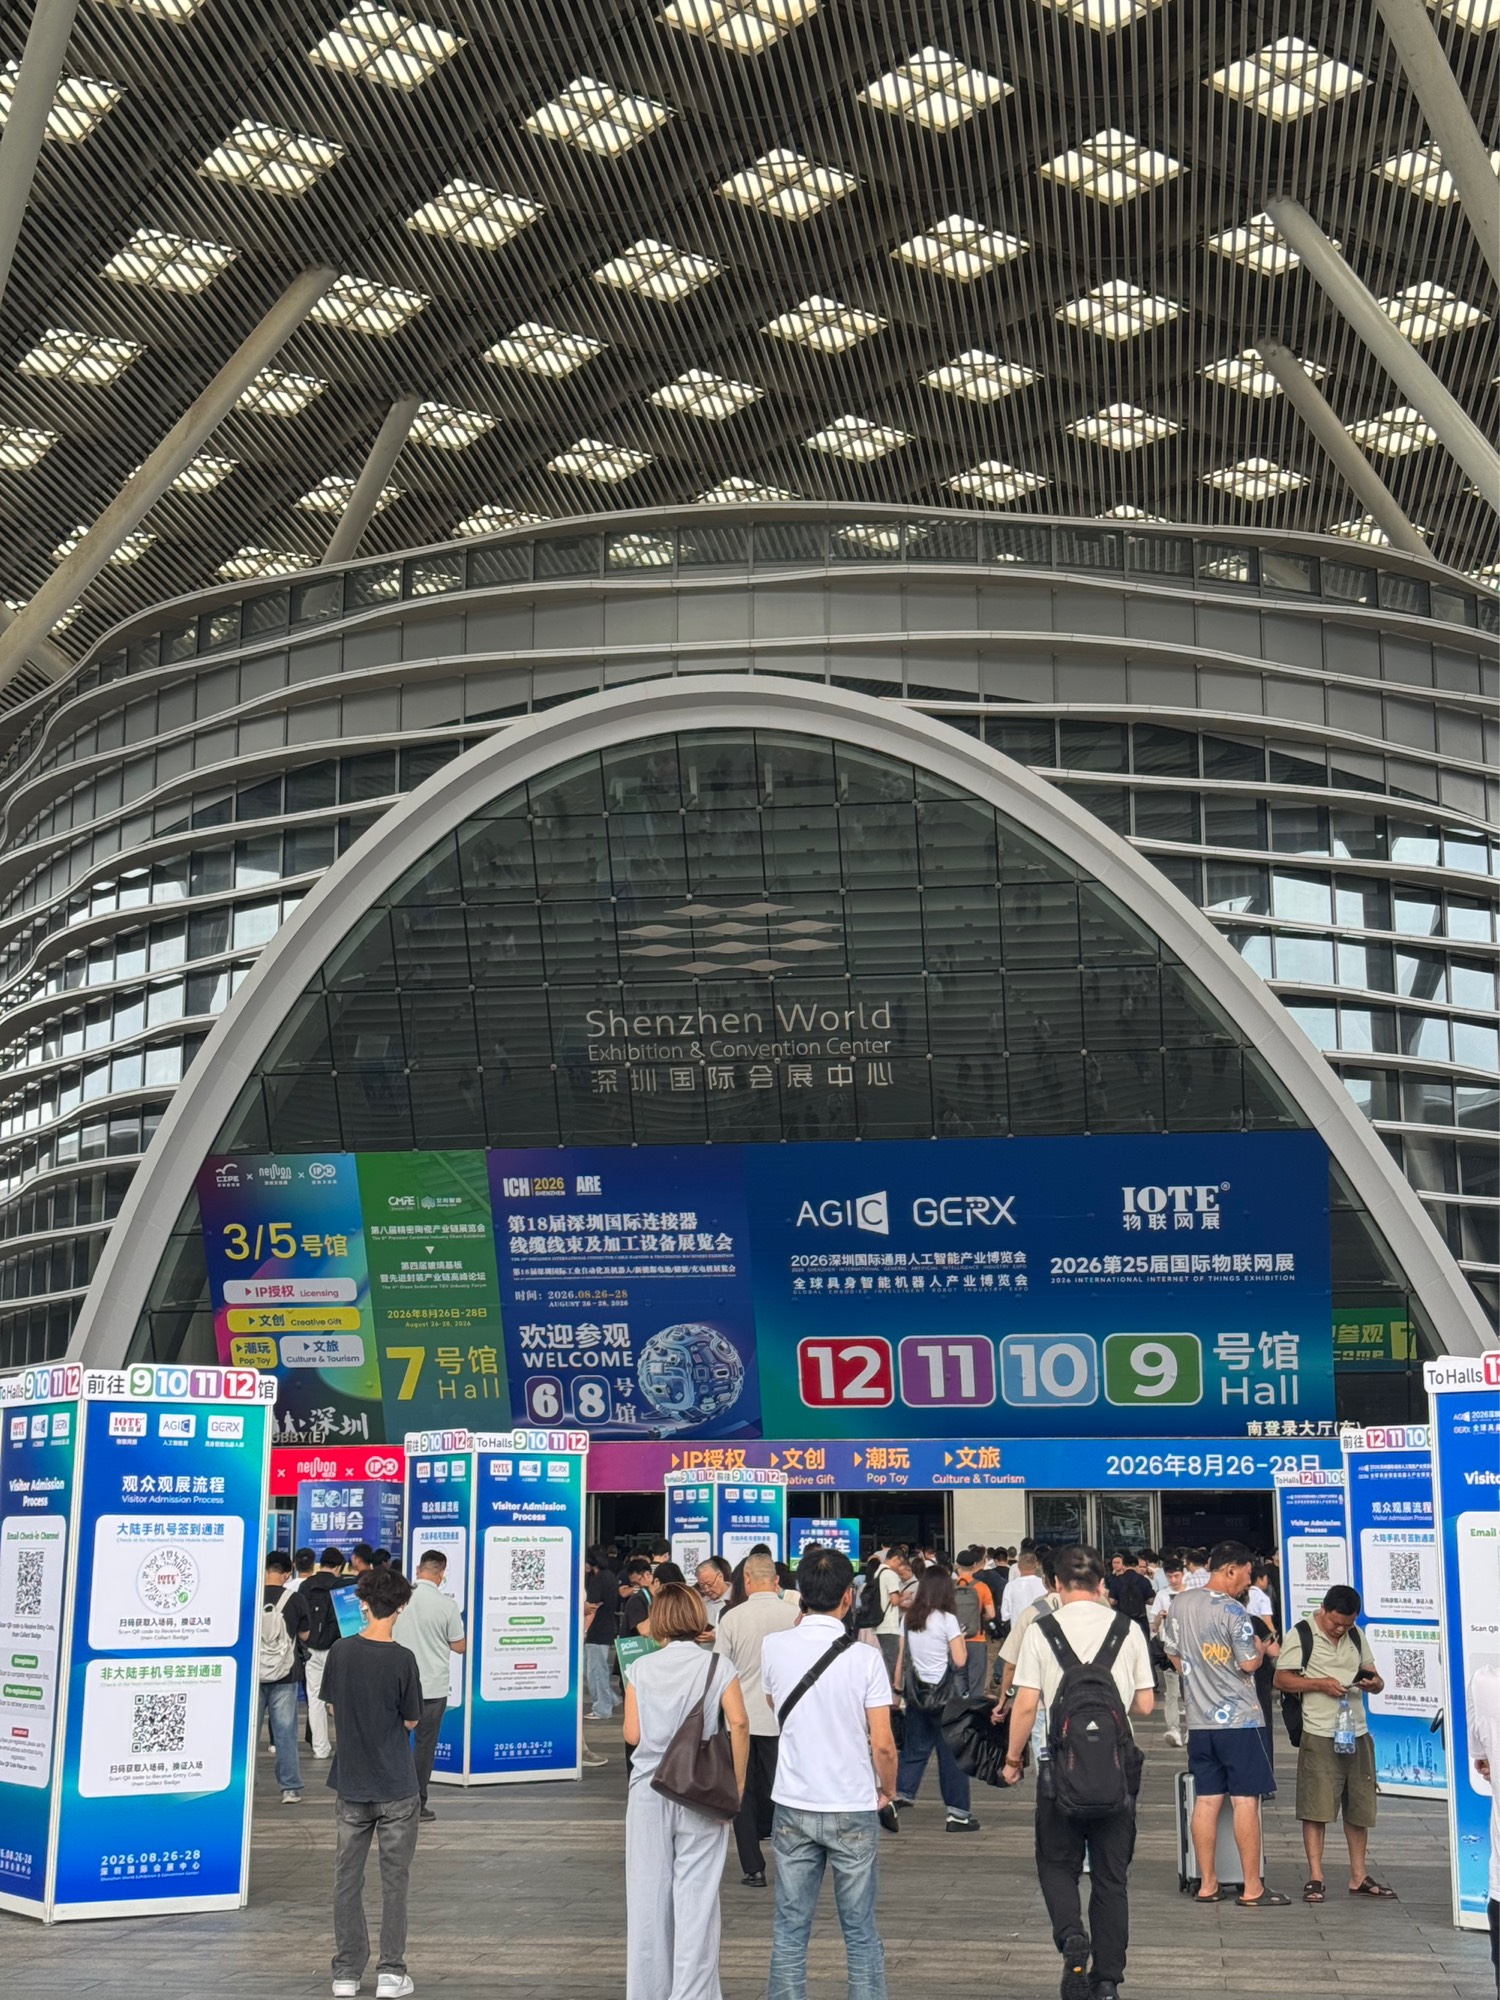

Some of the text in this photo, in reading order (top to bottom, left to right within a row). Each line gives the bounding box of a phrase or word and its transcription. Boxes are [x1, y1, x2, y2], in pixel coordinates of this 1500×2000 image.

[585, 1001, 891, 1038] Shenzhen World
[588, 1037, 891, 1062] Exhibition & Convention Center
[592, 1062, 894, 1094] 深圳国际会展中心
[502, 1175, 602, 1197] ICH 2026 ARE
[912, 1195, 1017, 1227] GERX
[507, 1211, 698, 1234] 第18届深圳国际连接器
[1122, 1212, 1220, 1232] 物联网展
[509, 1233, 734, 1255] 线缆线束及加工设备展览会
[401, 1260, 463, 1271] 第四届玻璃基板
[791, 1251, 1027, 1267] 2026深圳国际通用人工智能产业博览会
[1050, 1253, 1295, 1275] 2026第25届国际物联网展
[792, 1273, 1028, 1290] 全球具身智能机器人产业博览会
[1050, 1276, 1072, 1284] 2026
[1074, 1276, 1143, 1284] INTERNATIONAL
[1146, 1275, 1190, 1283] INTERNET
[1208, 1275, 1241, 1283] THINGS
[1243, 1274, 1296, 1282] EXHIBITION
[255, 1285, 339, 1298] IP授权 Licensing
[549, 1300, 580, 1308] AUGUST
[259, 1313, 342, 1327] 文创 Creative Gift
[387, 1308, 488, 1319] 2026年8月26日-28日
[519, 1322, 632, 1349] 欢迎参观
[1332, 1324, 1384, 1344] 参观
[244, 1340, 339, 1354] 潮玩 文旅
[239, 1357, 256, 1366] Pop
[257, 1356, 271, 1366] Toy
[319, 1355, 325, 1363] &
[326, 1355, 360, 1363] Tourism
[522, 1351, 634, 1369] WELCOME
[806, 1330, 1300, 1400] 12 11 10 9 号馆
[385, 1345, 498, 1400] 7 号馆
[1427, 1367, 1483, 1385] To Halls
[87, 1368, 275, 1400] 前往 9 10 11 12 馆
[438, 1377, 500, 1400] Hall
[1220, 1374, 1299, 1406] Hall
[532, 1382, 560, 1418] 6
[578, 1382, 606, 1418] 8
[421, 1433, 429, 1452] 9
[430, 1432, 441, 1451] 10
[443, 1432, 453, 1450] 11
[454, 1431, 466, 1450] 12
[477, 1432, 587, 1450] To Halls 9 10 11 12
[1342, 1429, 1426, 1449] 前往 12 11 10
[683, 1446, 1001, 1470] IP授权 文创 潮玩 文旅
[1106, 1453, 1320, 1477] 2026年8月26-28日
[9, 1476, 65, 1492] Visitor Admission
[122, 1475, 225, 1494] 观众观展流程
[815, 1472, 1025, 1485] Gift Pop Toy Culture & Tourism
[1283, 1476, 1300, 1484] Halls
[1300, 1471, 1313, 1484] 12
[1314, 1471, 1325, 1484] 11
[1326, 1471, 1340, 1484] 10
[22, 1495, 49, 1508] Process
[121, 1495, 224, 1505] Visitor Admission Process
[492, 1501, 567, 1511] Visitor Admission
[1371, 1501, 1433, 1514] 观众观展流程
[310, 1511, 364, 1531] 智博会
[512, 1512, 546, 1521] Process
[1310, 1519, 1341, 1527] Admission
[117, 1522, 225, 1536] 大陆手机号签到通道
[1470, 1528, 1497, 1537] Email
[1470, 1624, 1499, 1633] Scan QR
[100, 1664, 223, 1681] 非大陆手机号签到通道
[101, 1849, 201, 1866] 2026.08.26-28
